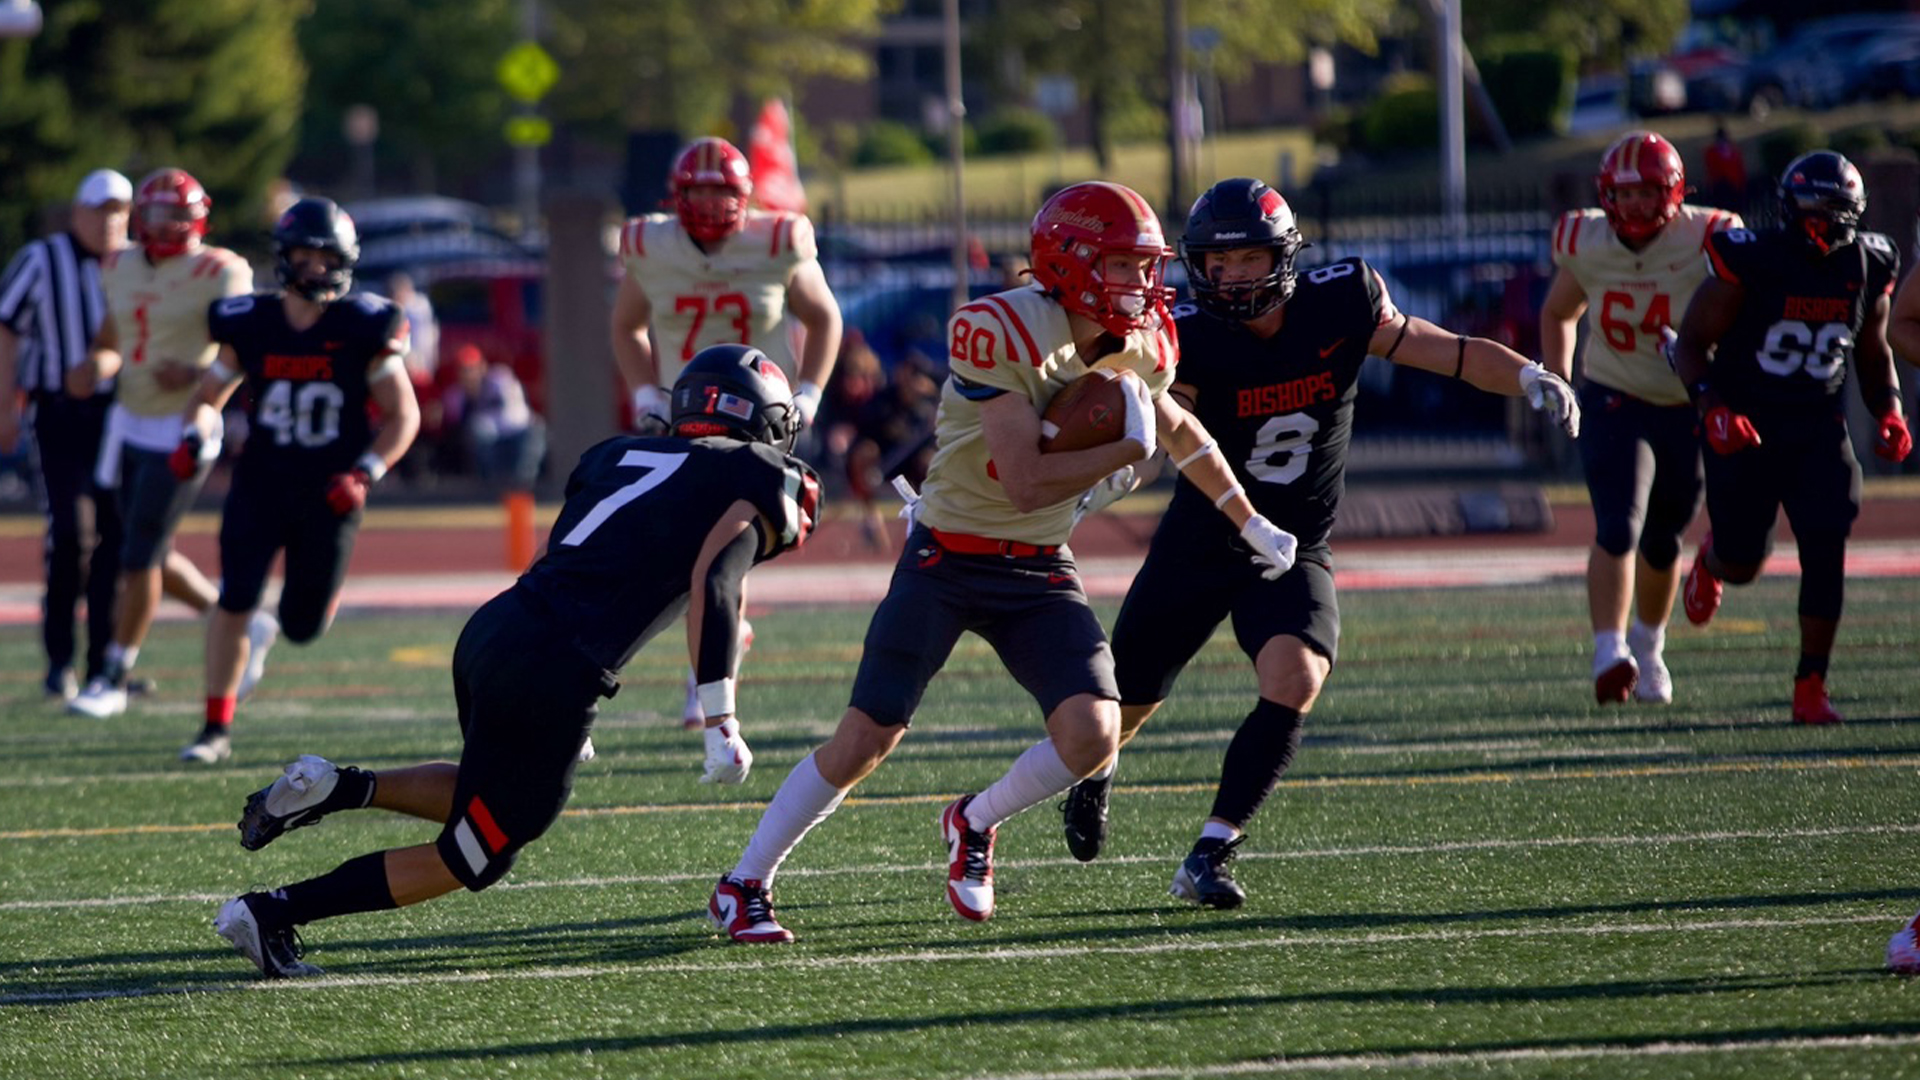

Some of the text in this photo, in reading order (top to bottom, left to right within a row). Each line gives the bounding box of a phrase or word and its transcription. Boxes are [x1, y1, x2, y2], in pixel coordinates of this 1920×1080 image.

[1307, 263, 1355, 284] 8
[674, 293, 751, 361] 73
[951, 317, 997, 369] 80
[1601, 290, 1671, 354] 64
[259, 379, 344, 446] 40
[703, 386, 719, 414] 7
[1237, 370, 1337, 418] BISHOPS
[1245, 411, 1320, 485] 8
[560, 449, 690, 547] 7
